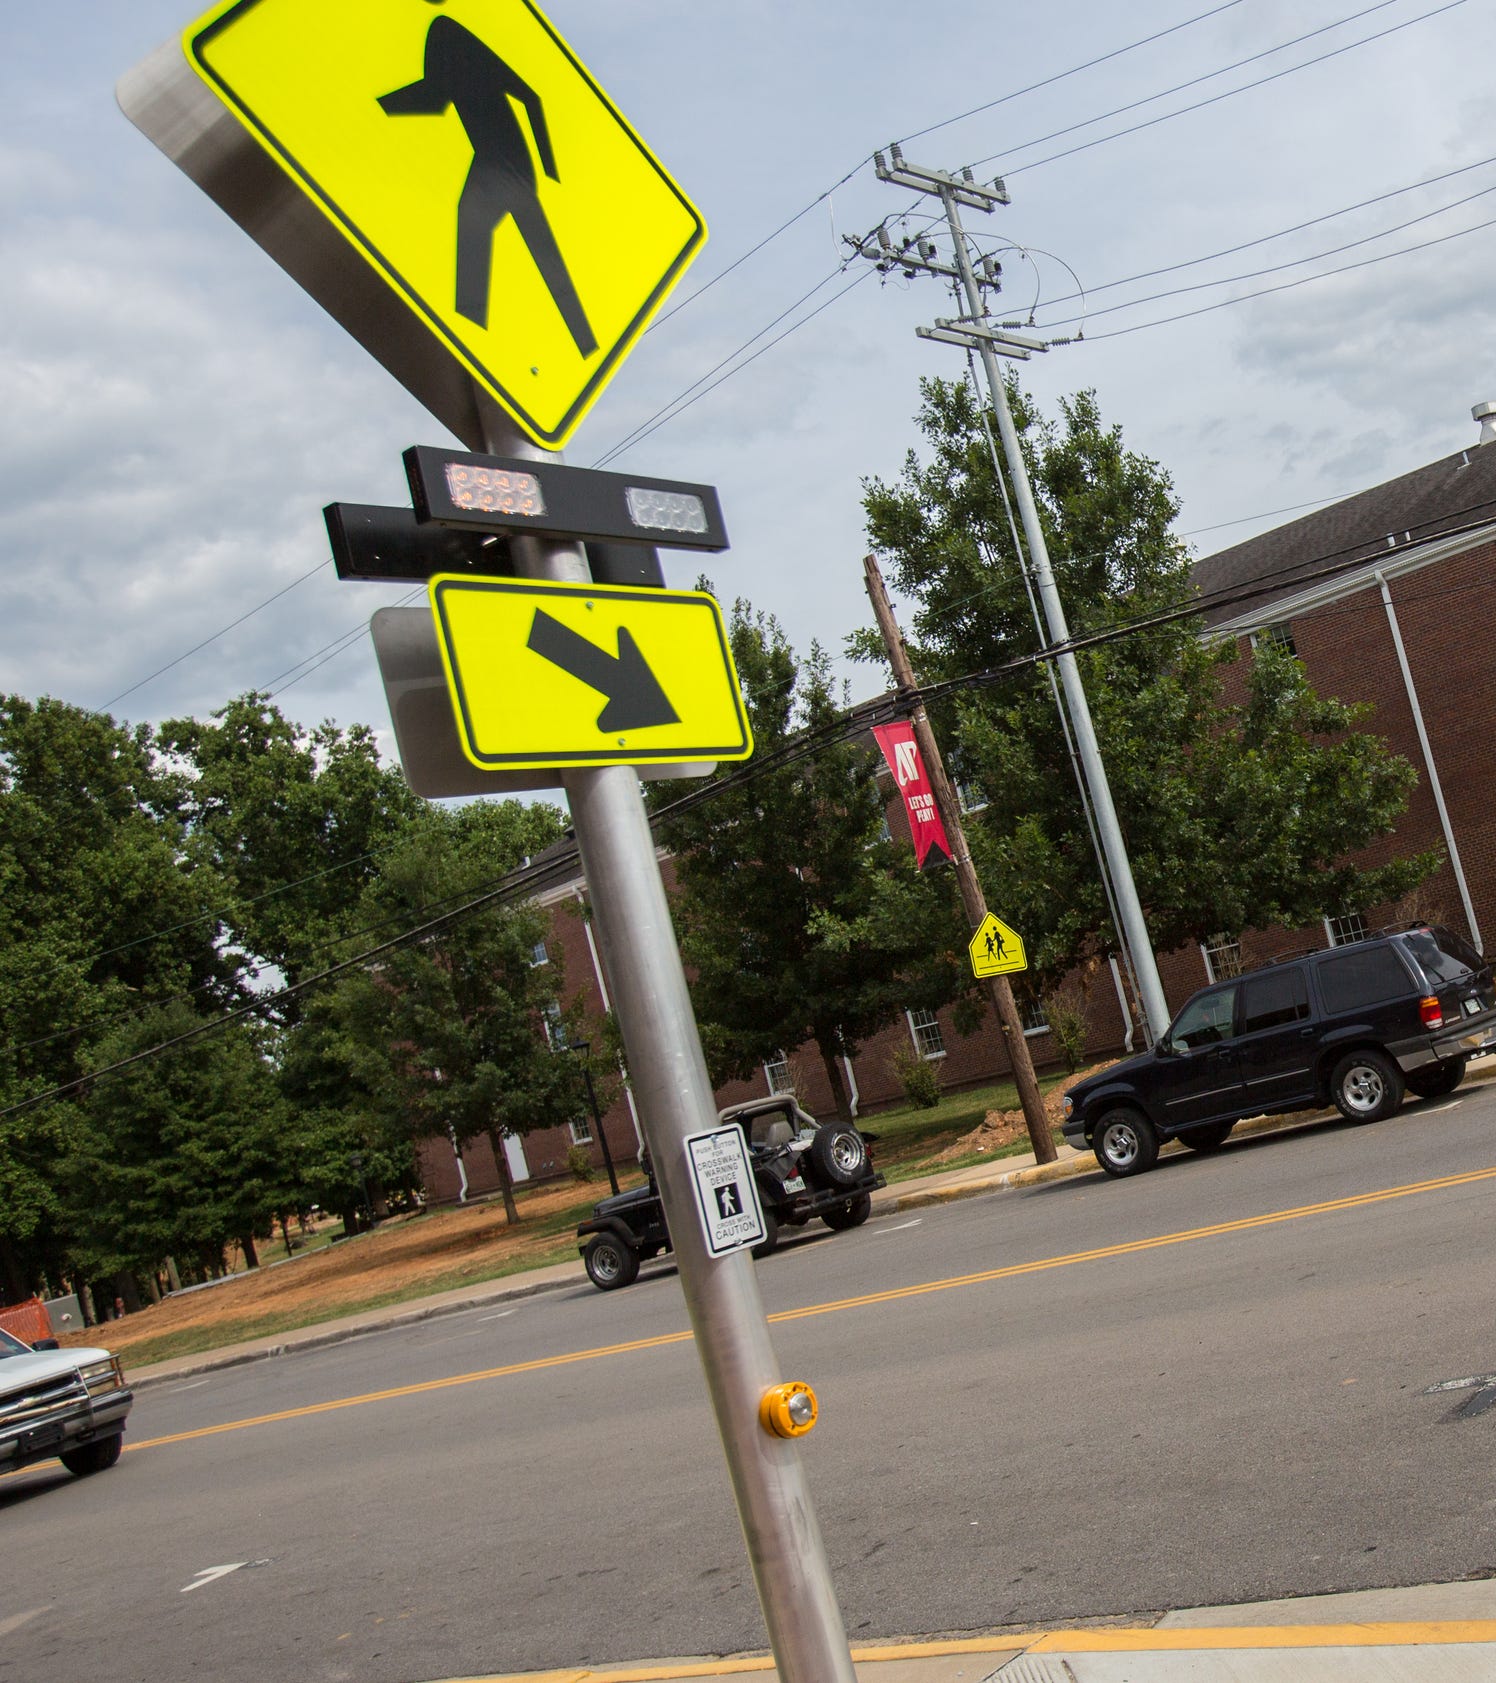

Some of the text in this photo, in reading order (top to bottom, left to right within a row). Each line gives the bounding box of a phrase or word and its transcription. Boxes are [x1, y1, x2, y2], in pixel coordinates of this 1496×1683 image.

[908, 793, 934, 810] LET'S GO
[713, 1140, 736, 1150] BUTTON
[697, 1153, 741, 1171] CROSSWALK
[704, 1162, 738, 1178] WARNING
[710, 1171, 737, 1186] DEVICE
[715, 1220, 756, 1240] CAUTION
[716, 1215, 751, 1230] CROSS WITH
